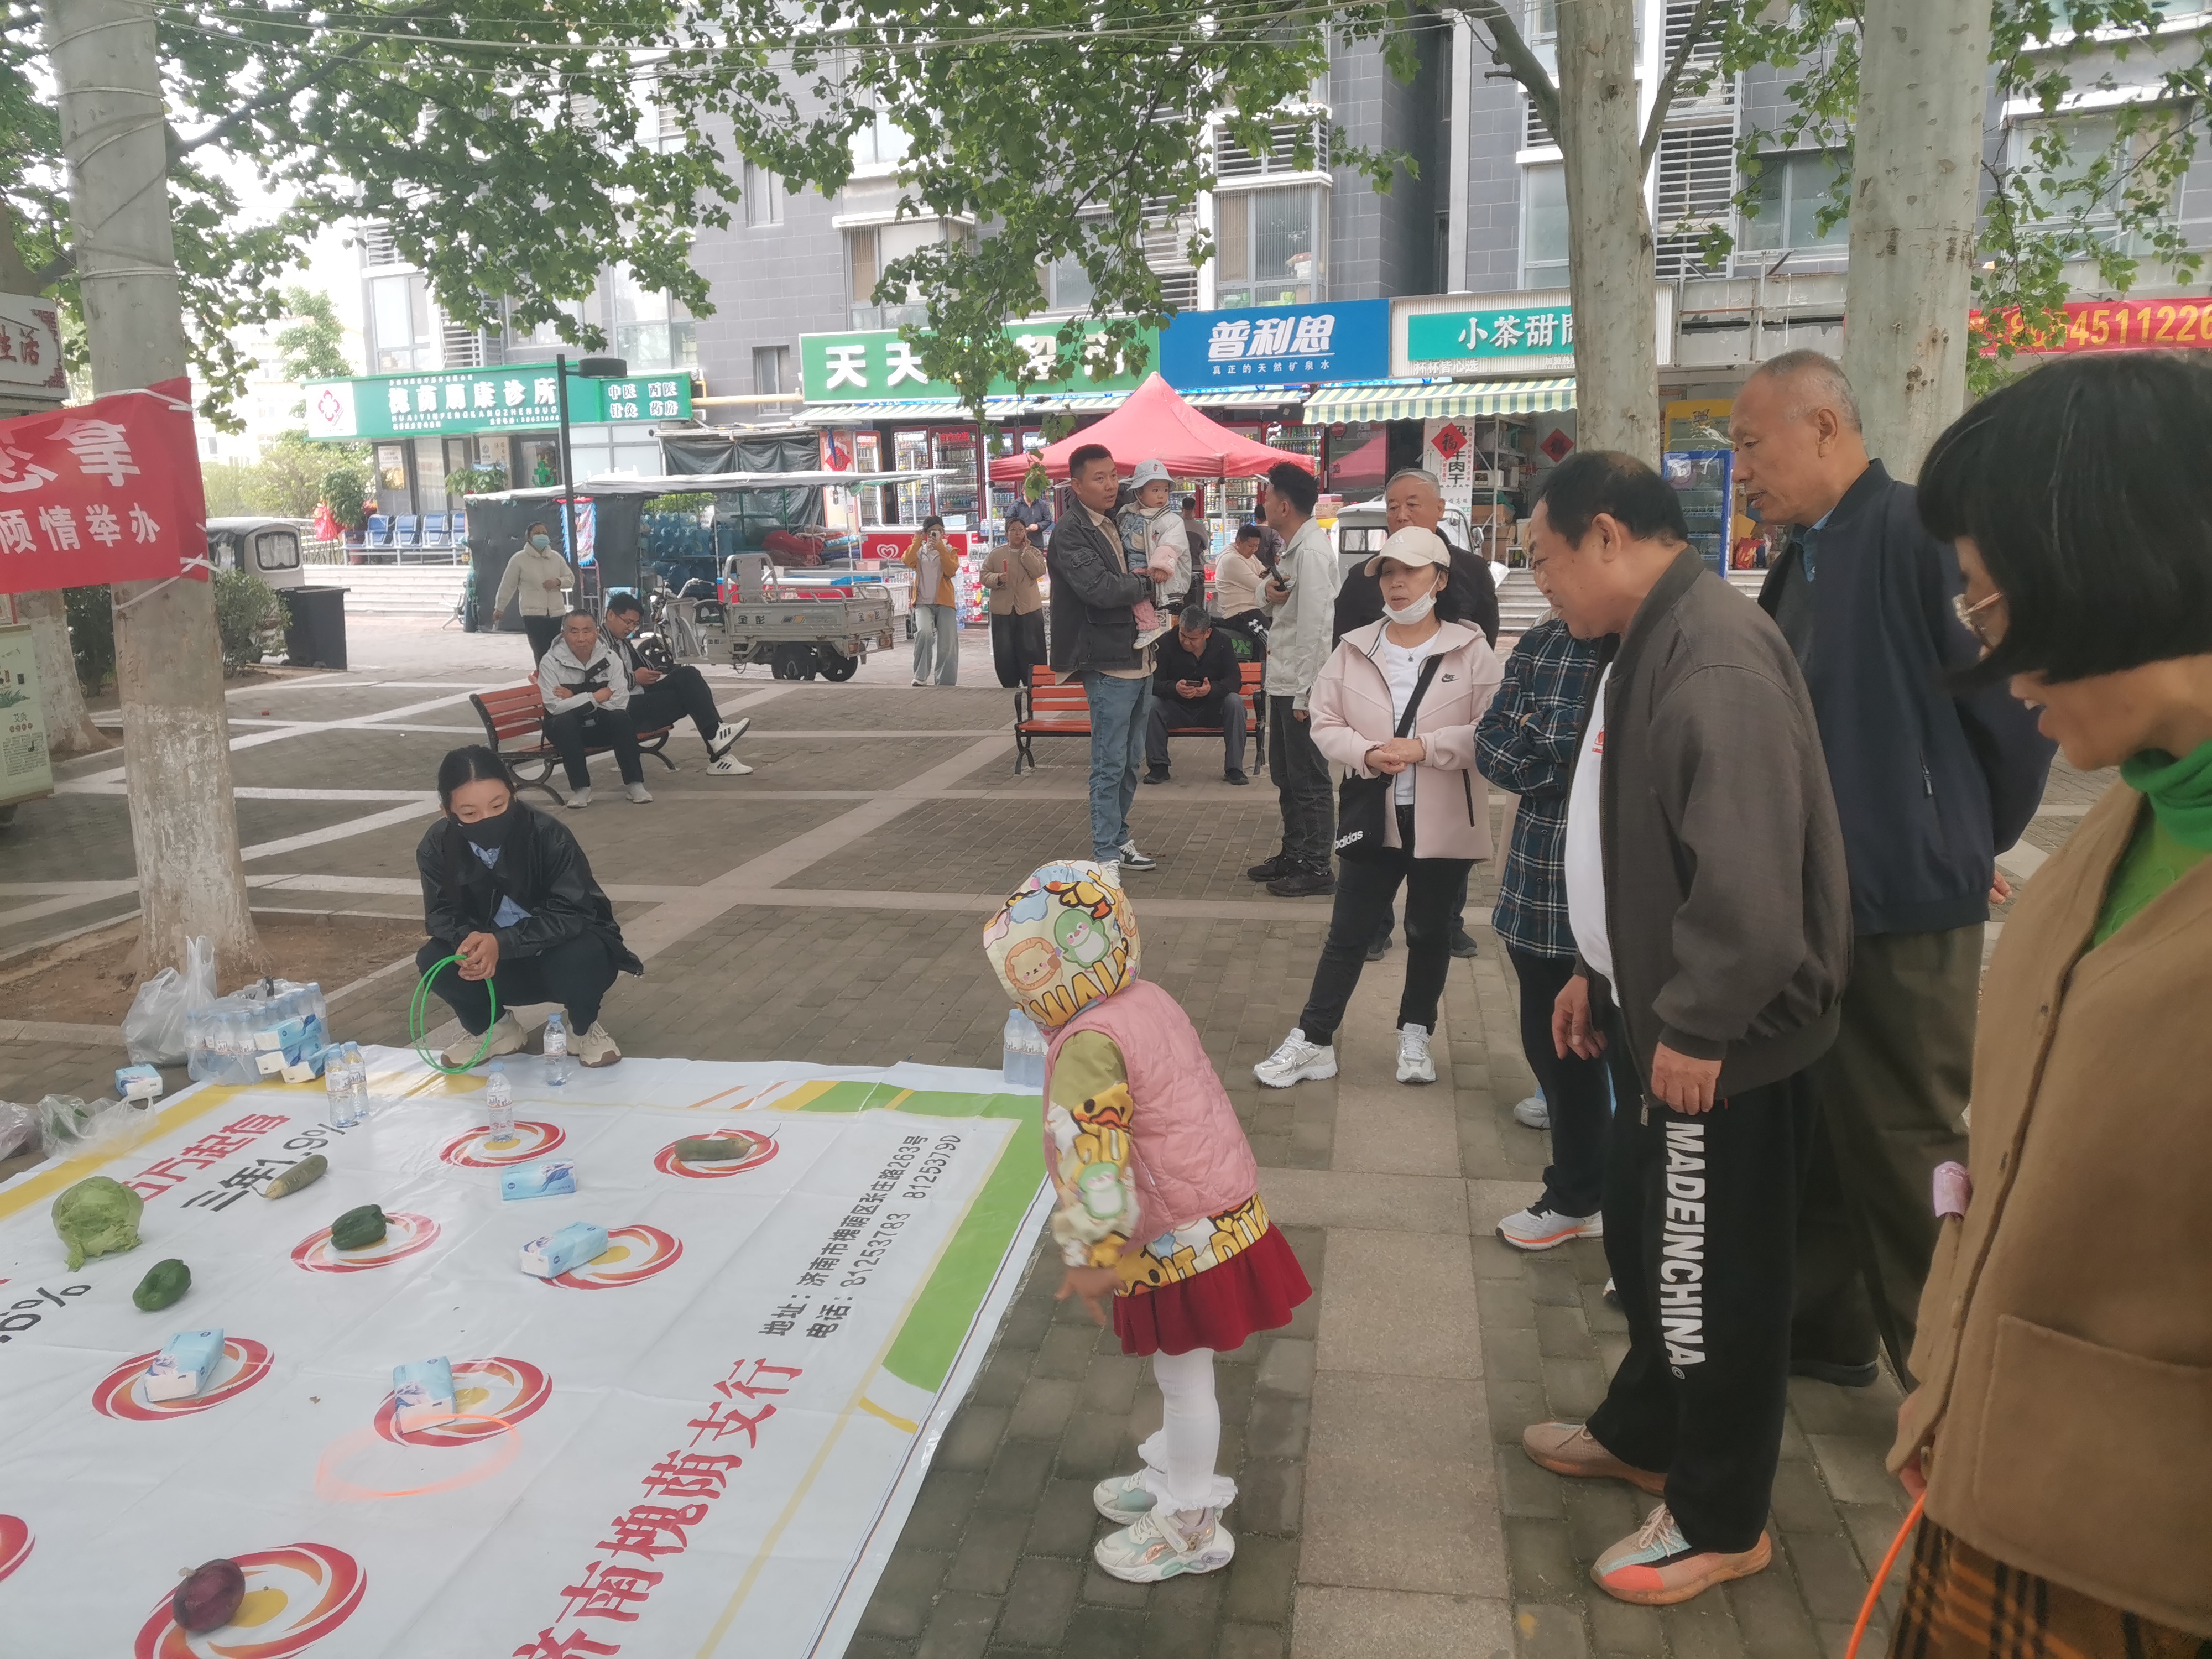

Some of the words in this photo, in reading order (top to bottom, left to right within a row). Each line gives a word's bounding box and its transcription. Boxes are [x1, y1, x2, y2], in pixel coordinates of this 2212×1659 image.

[1208, 314, 1335, 358] 普利思
[1212, 359, 1330, 375] 真正的天然矿泉水
[1414, 359, 1479, 374] 杯杯皆心选
[608, 383, 637, 400] 中医
[648, 381, 677, 398] 西医
[610, 402, 639, 418] 针灸
[649, 400, 678, 416] 药房
[1442, 432, 1458, 452] 福
[738, 615, 765, 624] 金彭
[1334, 830, 1364, 850] adidas
[902, 1135, 961, 1199] 81253790
[1660, 1121, 1706, 1365] MADEINCHINA
